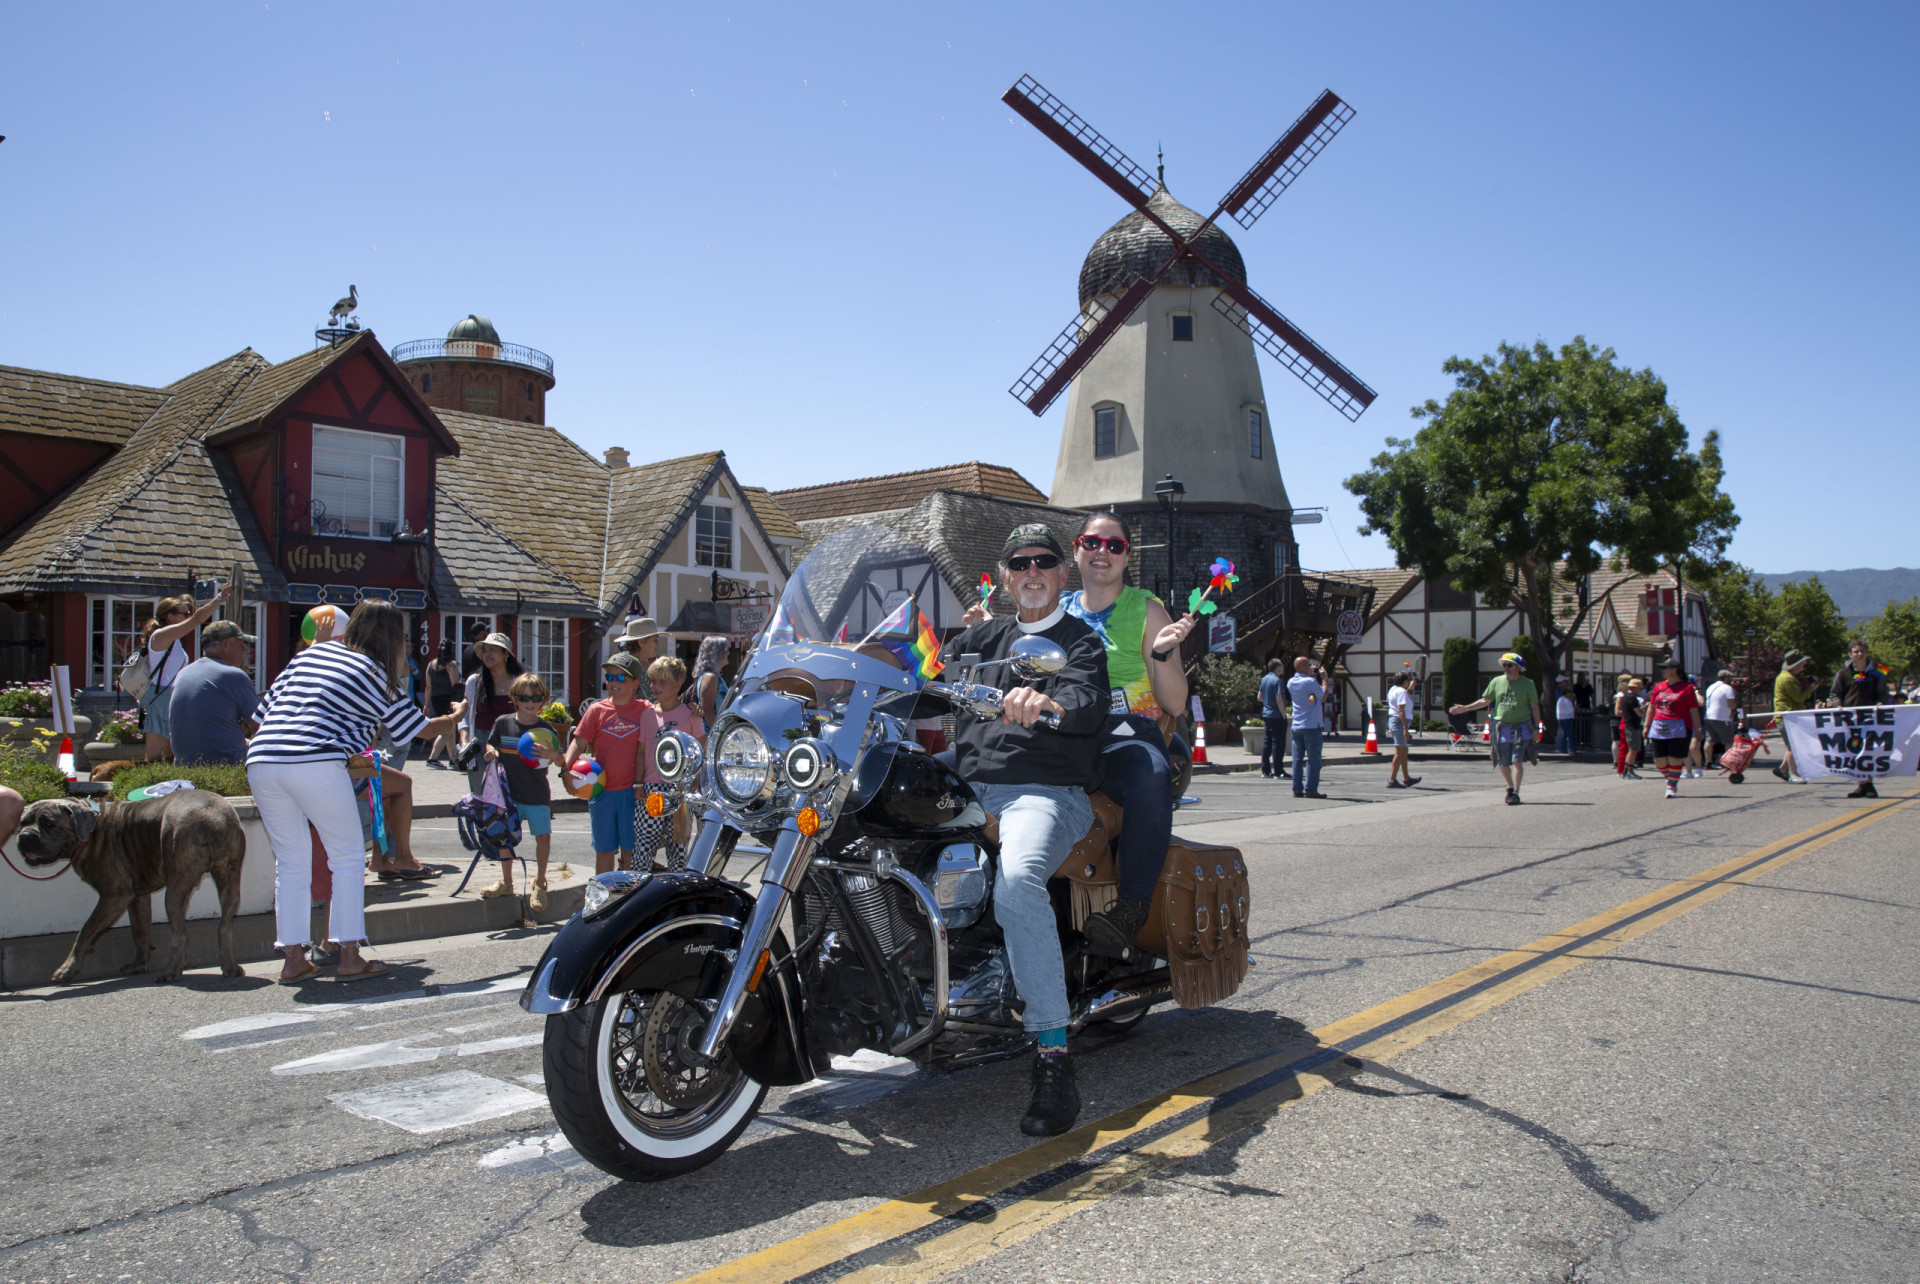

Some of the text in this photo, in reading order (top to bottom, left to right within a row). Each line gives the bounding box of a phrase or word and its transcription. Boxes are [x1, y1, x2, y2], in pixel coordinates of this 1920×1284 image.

[287, 545, 366, 574] Vinhus
[736, 609, 764, 622] Solvang
[420, 620, 429, 655] 440
[1814, 708, 1895, 729] FREE
[1818, 728, 1894, 753] MOM
[1824, 755, 1891, 772] HUGS
[683, 944, 715, 955] Vintage
